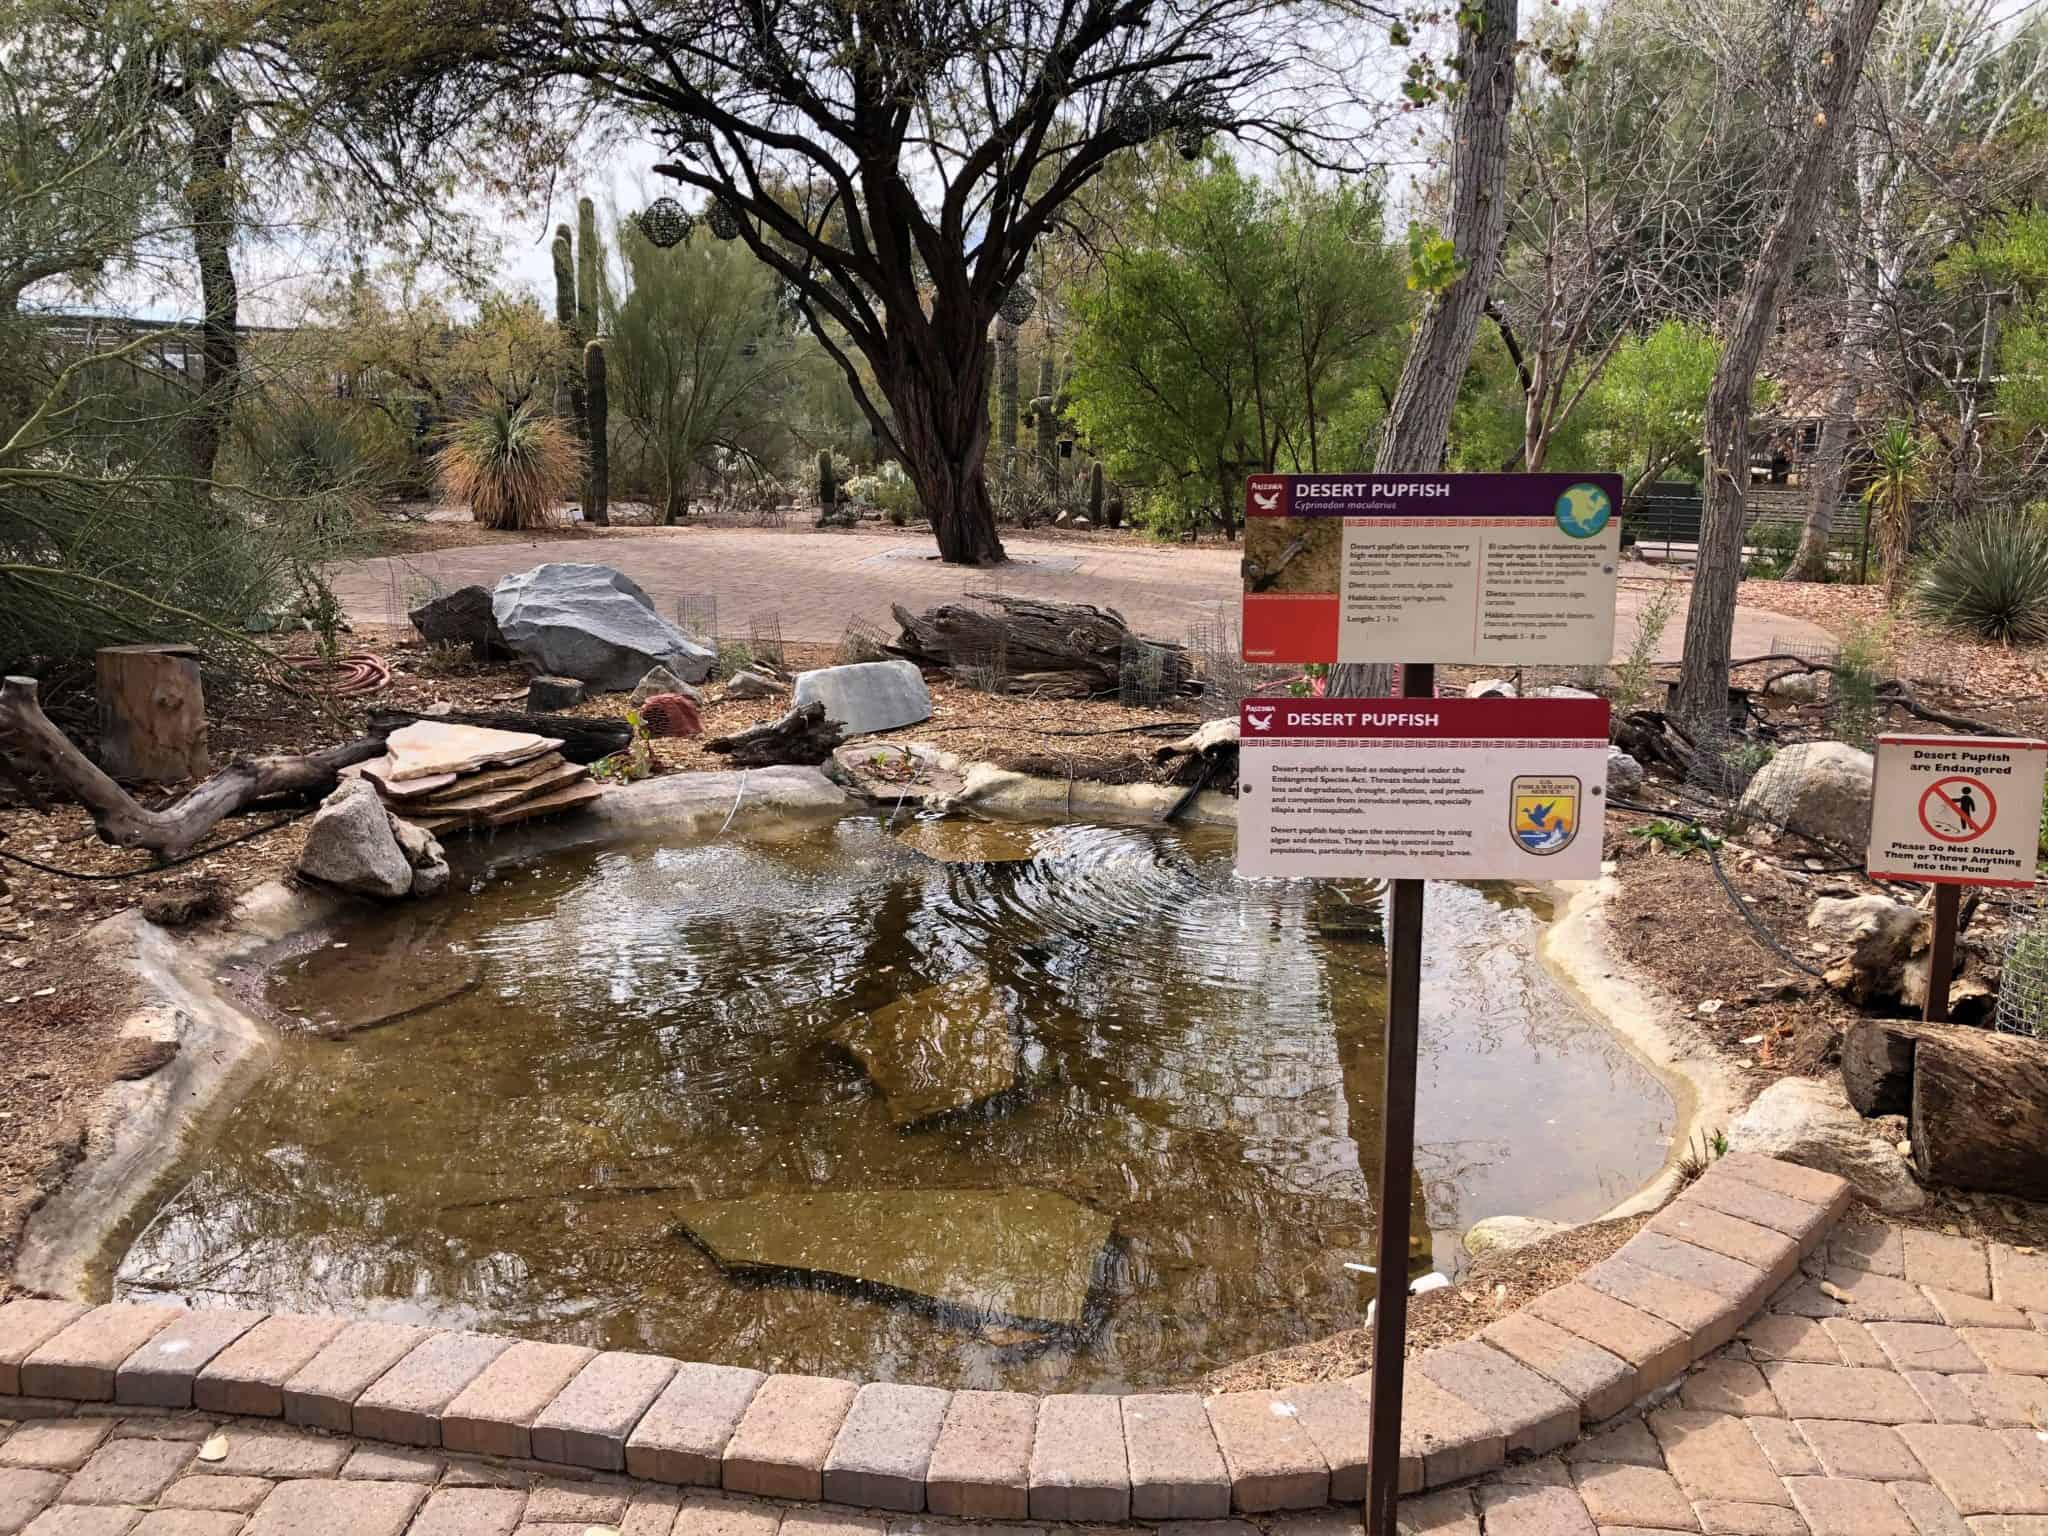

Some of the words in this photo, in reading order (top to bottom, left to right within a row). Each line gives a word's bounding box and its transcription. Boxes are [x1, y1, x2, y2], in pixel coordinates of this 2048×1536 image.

[1296, 483, 1367, 497] DESERT
[1371, 483, 1450, 497] PUPFISH
[1295, 500, 1344, 511] Cyprinodon
[1347, 501, 1397, 510] macularius
[1287, 713, 1356, 726] DESERT
[1361, 713, 1439, 726] PUPFISH
[1914, 751, 1957, 760] Desert
[1962, 752, 2010, 763] Pupfish
[1935, 763, 2012, 775] Endangered
[1892, 842, 1925, 850] Please
[1948, 845, 1969, 853] Not
[1973, 847, 2015, 855] Disturb
[1884, 851, 1914, 859] Them
[1932, 853, 1967, 862] Throw
[1971, 856, 2021, 867] Anything
[1913, 862, 1936, 870] Into
[1940, 863, 1958, 871] the
[1962, 865, 1989, 873] Pond
